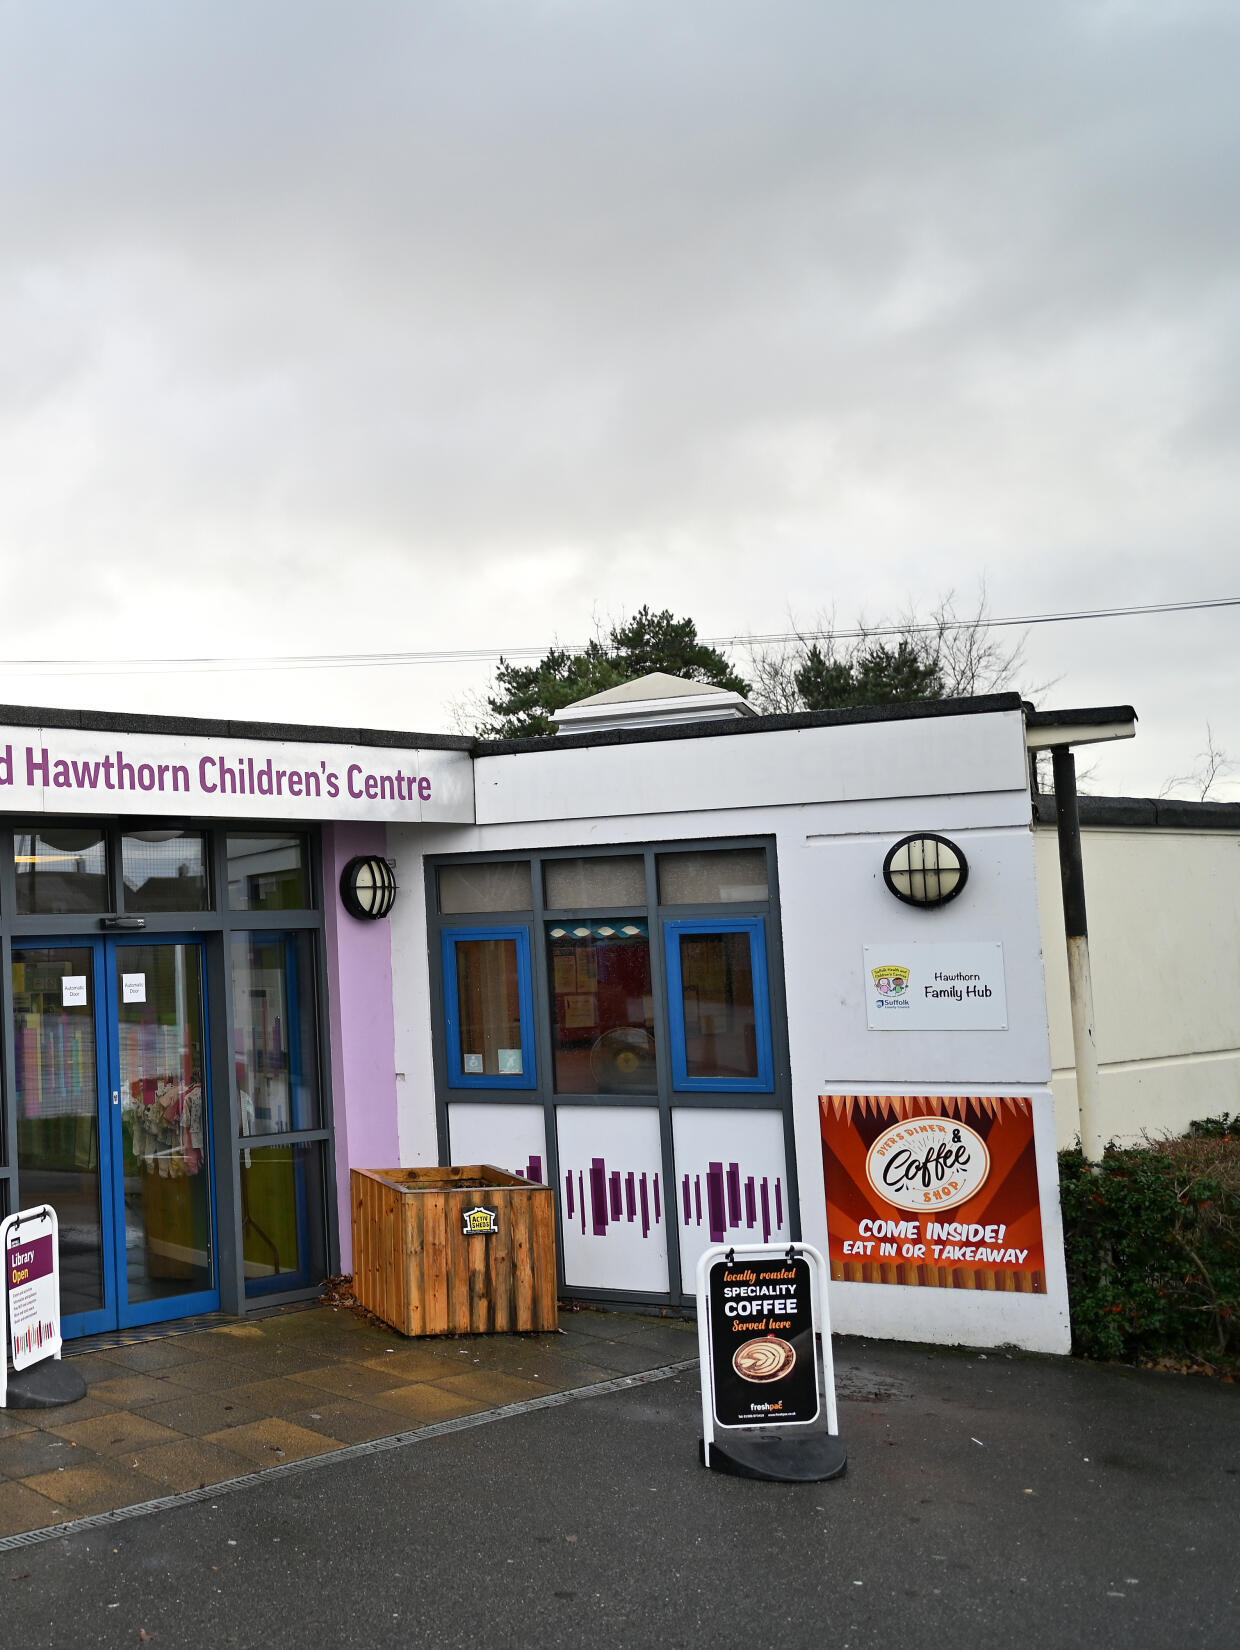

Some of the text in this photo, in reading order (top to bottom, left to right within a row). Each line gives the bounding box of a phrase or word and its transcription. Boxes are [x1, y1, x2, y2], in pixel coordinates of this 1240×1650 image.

[25, 746, 190, 792] Hawthorn
[198, 756, 340, 798] Children's
[347, 764, 432, 801] Centre
[934, 972, 980, 982] Hawthorn
[924, 985, 992, 1001] Family Hub
[876, 1124, 962, 1157] DYER'S DINER &
[882, 1143, 971, 1188] Coffee
[923, 1181, 959, 1202] SHOP
[858, 1219, 1007, 1244] COME INSIDE!
[11, 1249, 35, 1268] Library
[843, 1240, 1029, 1264] EAT IN OR TAKEAWAY
[12, 1268, 29, 1284] Open
[723, 1267, 797, 1285] locally roasted
[723, 1284, 797, 1298] SPECIALITY
[724, 1299, 798, 1317] COFFEE
[732, 1318, 792, 1332] Served here
[750, 1400, 783, 1411] freshpac
